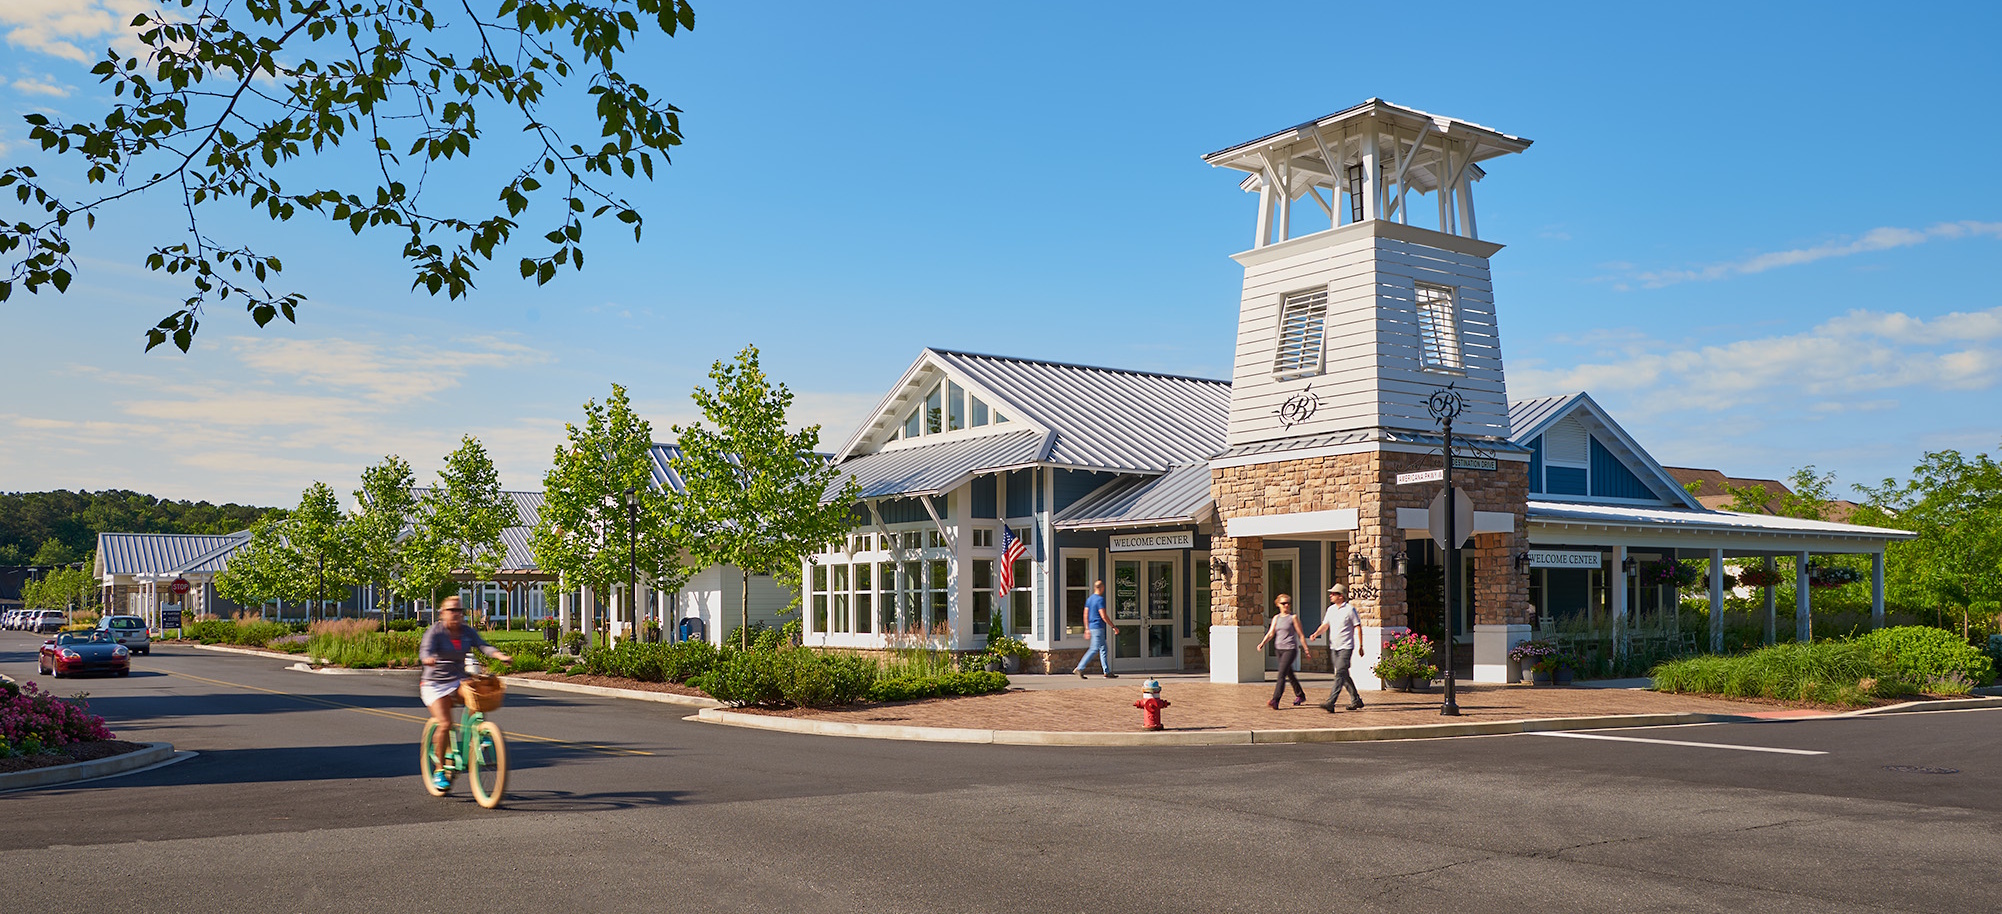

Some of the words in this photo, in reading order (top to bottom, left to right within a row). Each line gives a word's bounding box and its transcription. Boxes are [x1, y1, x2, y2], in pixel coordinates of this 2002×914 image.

[1482, 460, 1494, 469] DRIVE
[1399, 473, 1424, 482] AMERICANA
[1114, 537, 1154, 547] WELCOME
[1156, 535, 1189, 545] CENTER
[1529, 553, 1567, 564] WELCOME
[1569, 554, 1598, 565] CENTER
